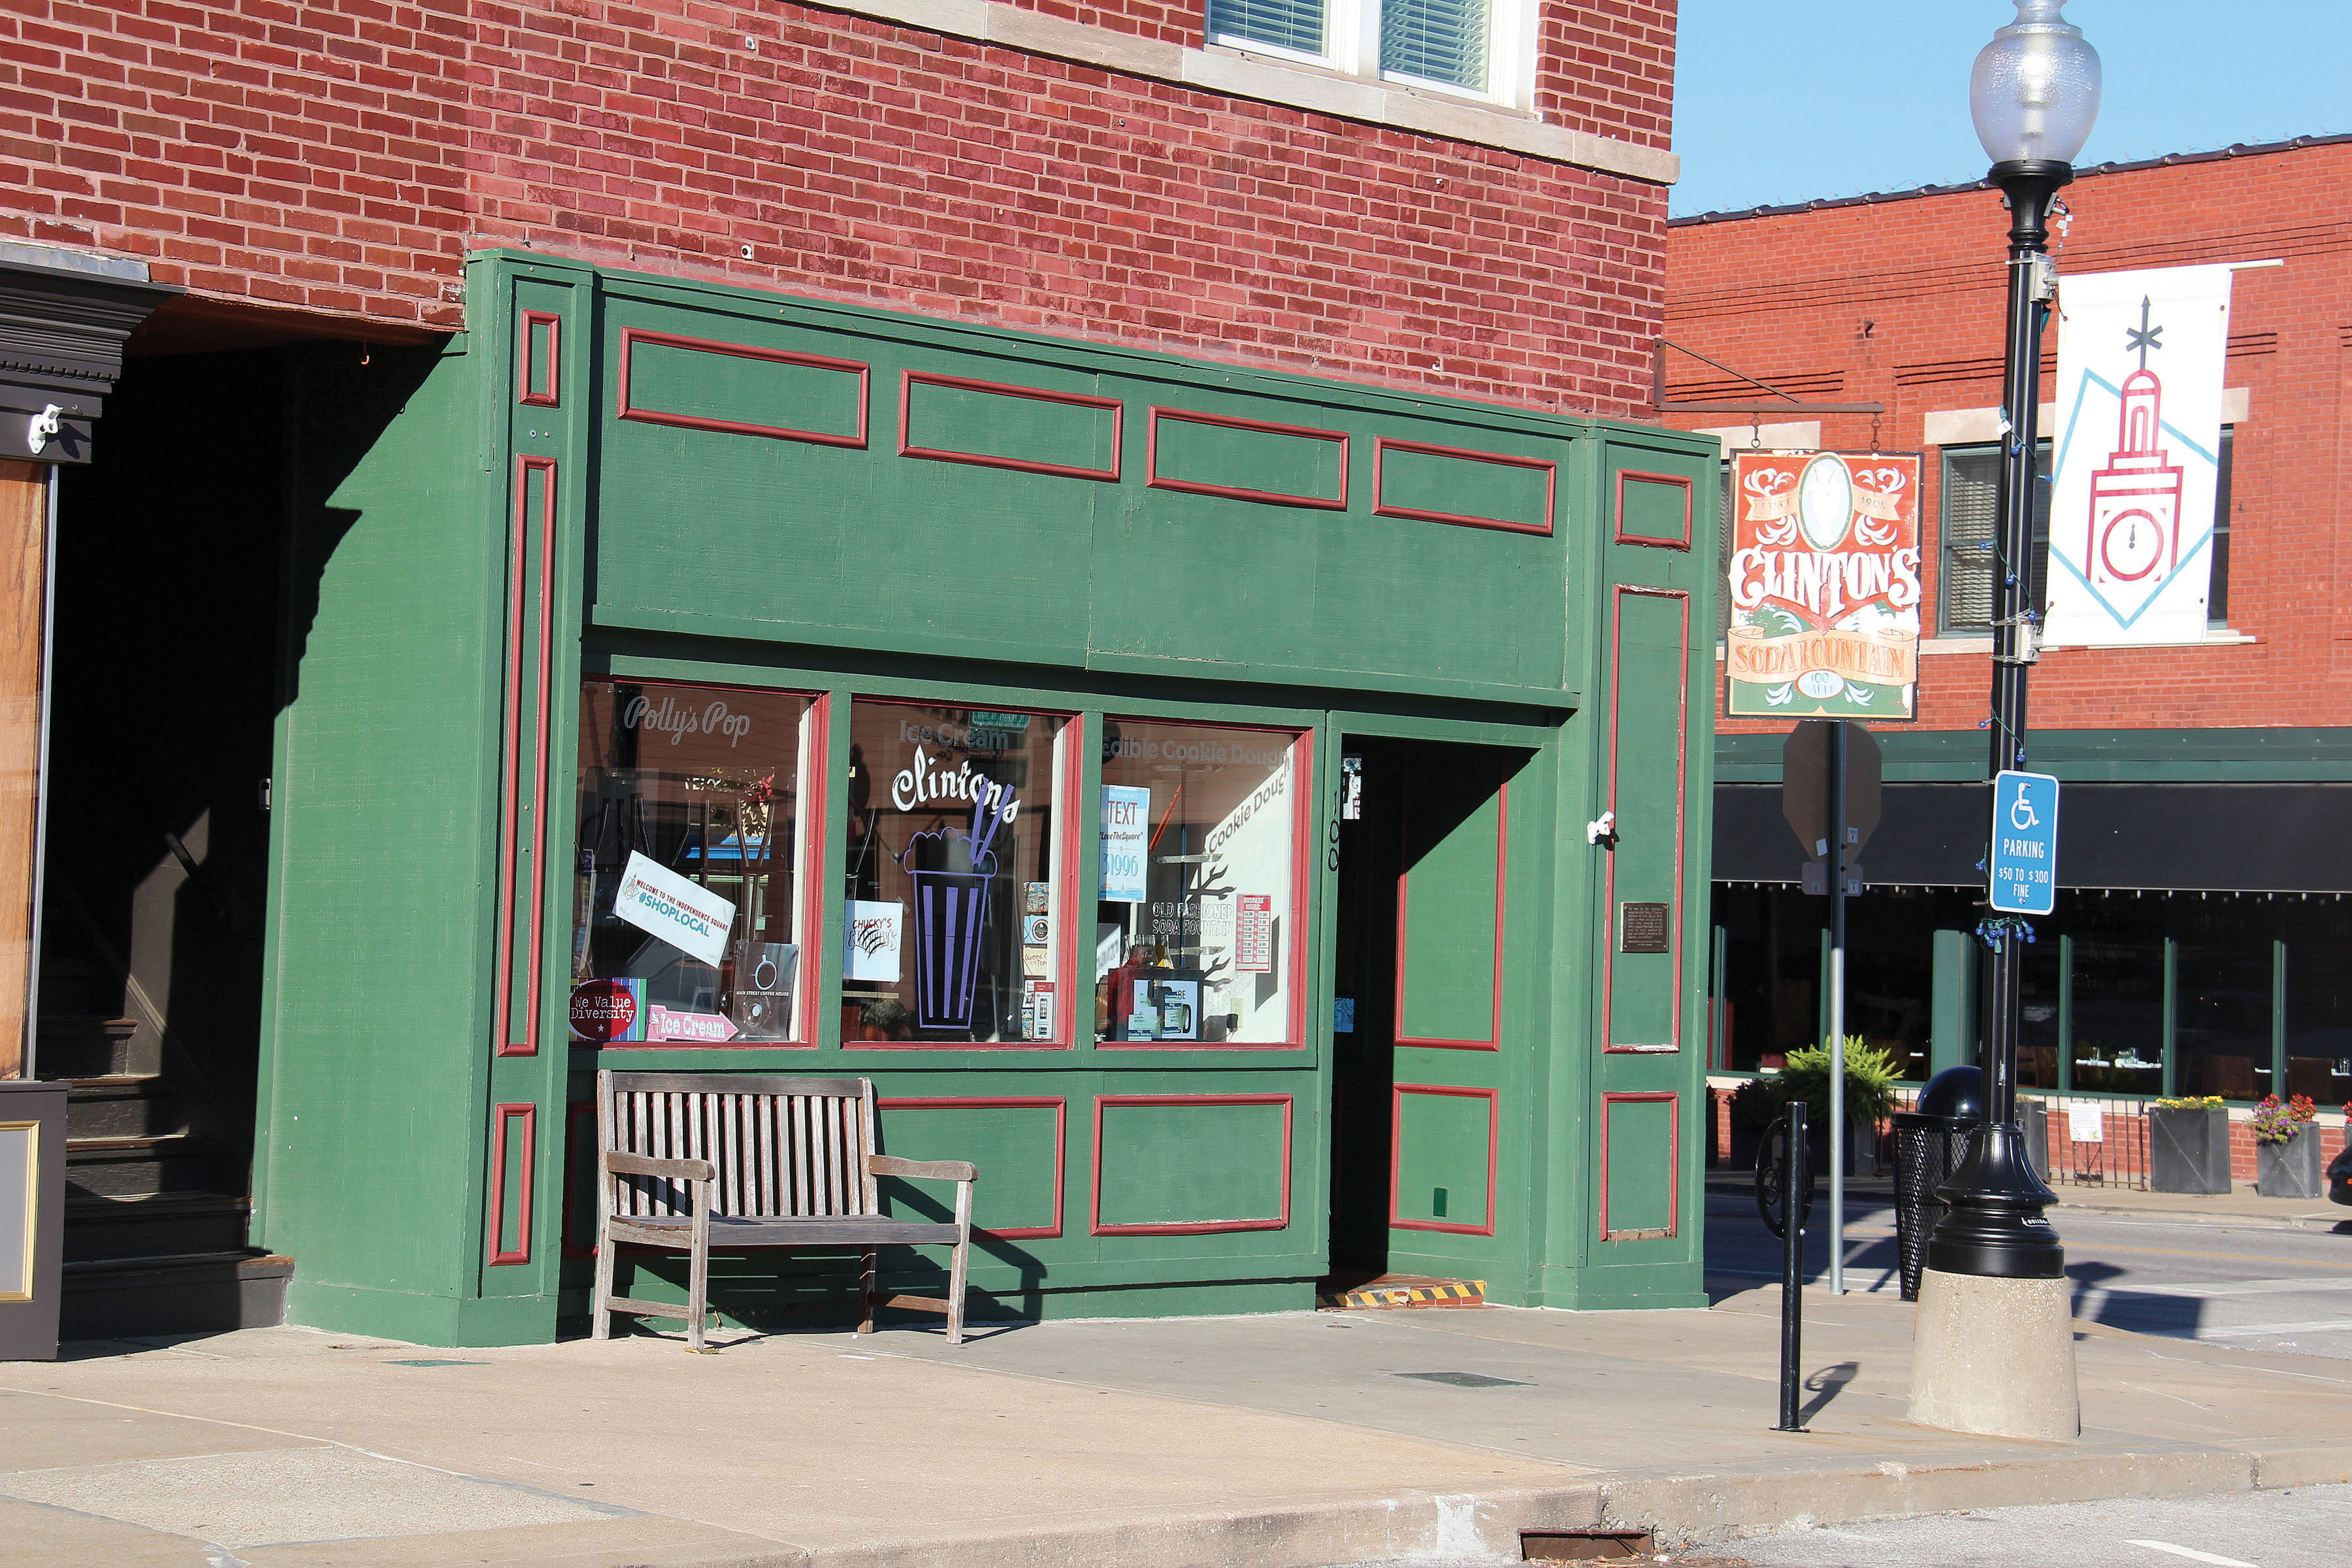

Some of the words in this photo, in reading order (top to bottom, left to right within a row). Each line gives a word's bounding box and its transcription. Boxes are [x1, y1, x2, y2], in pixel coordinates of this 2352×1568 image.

[1727, 544, 1921, 619] CLINTON'S
[1735, 642, 1793, 675] SODA
[1797, 638, 1906, 678] FOUNTAIN
[624, 695, 698, 745] Polly's
[702, 701, 751, 748] Pop
[899, 720, 933, 744] Ice
[938, 723, 1009, 750] Cream
[1102, 736, 1158, 760] Edible
[1163, 740, 1228, 762] Cookie
[1231, 744, 1287, 772] Dough
[1107, 800, 1138, 825] TEXT
[2003, 838, 2045, 859] PARKING
[1102, 853, 1139, 877] 31996
[1999, 867, 2013, 881] $50
[2015, 868, 2025, 881] TO
[2028, 870, 2049, 884] $300
[2013, 883, 2030, 898] FINE
[636, 879, 659, 896] WELCOME
[659, 890, 666, 900] TO
[666, 894, 676, 904] THE
[676, 899, 711, 922] INDEPENDENCE
[710, 917, 729, 932] SQUARE
[638, 891, 710, 938] #SHOPLOCAL
[1152, 902, 1175, 918] OLD
[1177, 903, 1234, 919] FASHIONED
[853, 917, 892, 929] CHUCKY'S
[1152, 919, 1181, 935] SODA
[1183, 919, 1233, 936] FOUNTAIN
[575, 996, 589, 1007] We
[594, 995, 631, 1008] Value
[570, 1006, 634, 1023] Diversity
[661, 1013, 681, 1034] Ice
[683, 1015, 726, 1038] Cream
